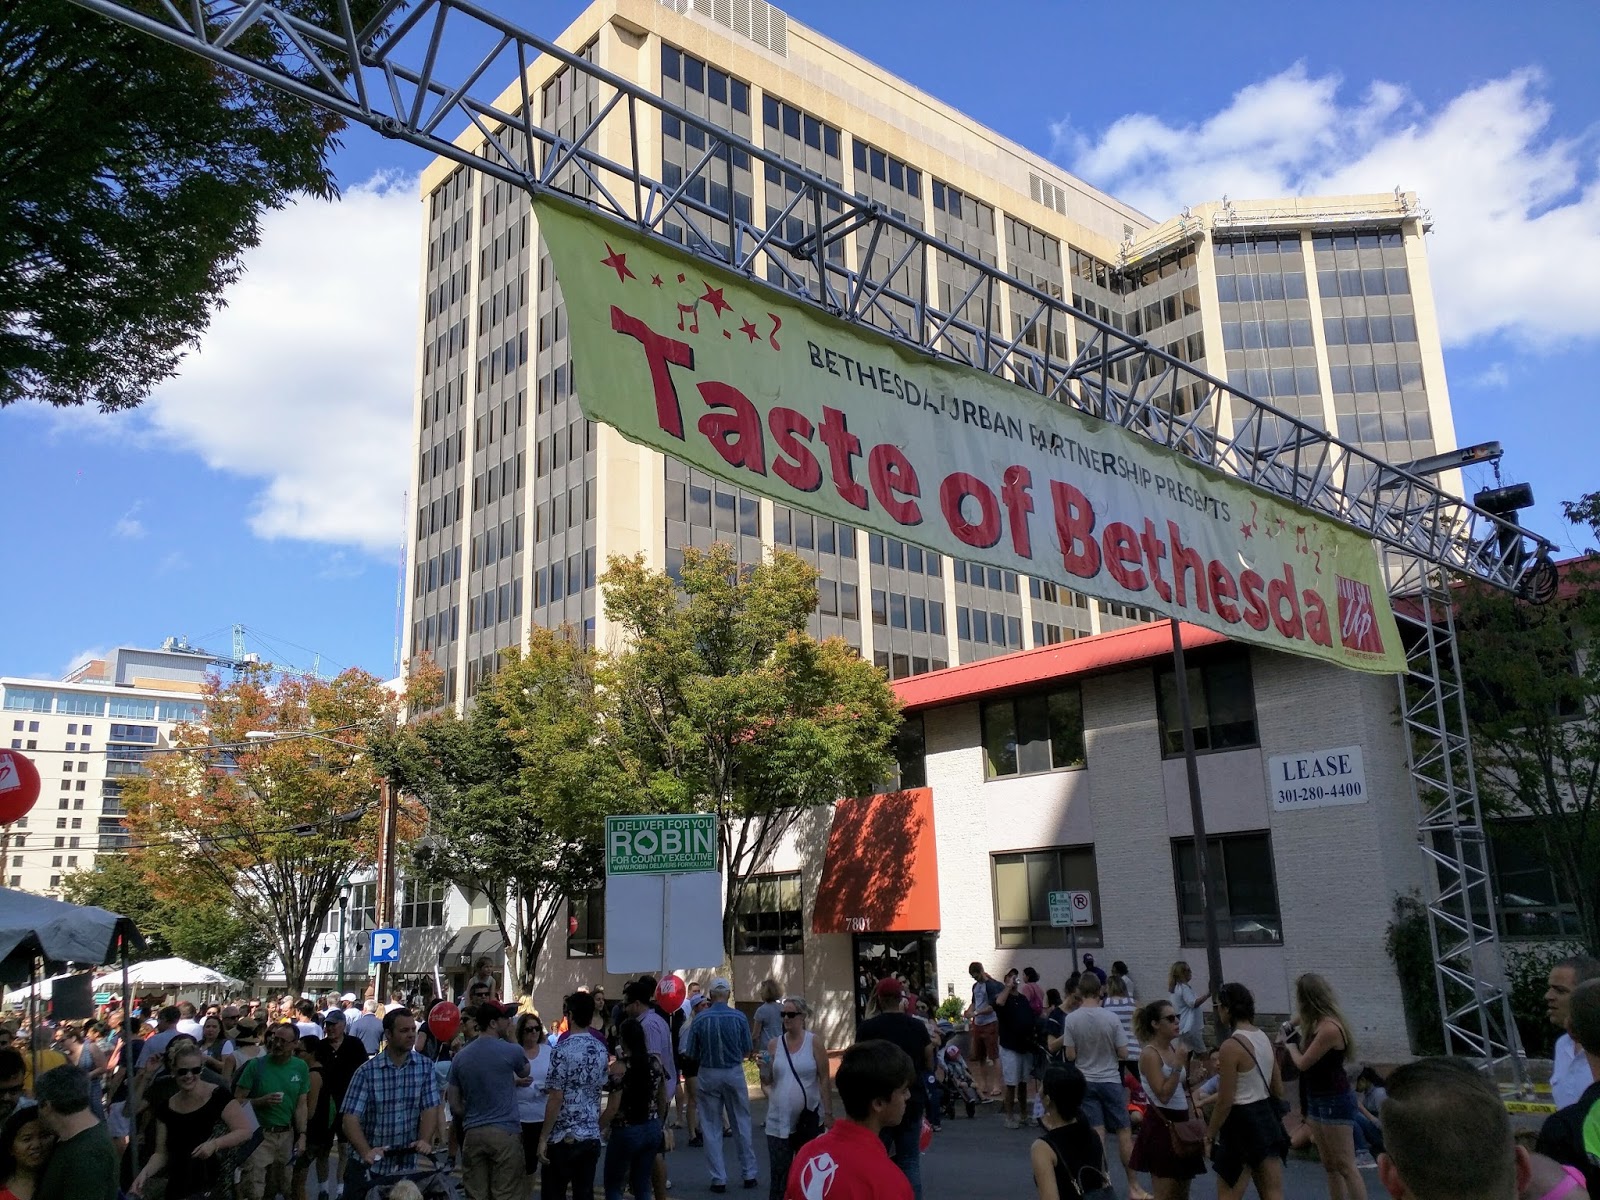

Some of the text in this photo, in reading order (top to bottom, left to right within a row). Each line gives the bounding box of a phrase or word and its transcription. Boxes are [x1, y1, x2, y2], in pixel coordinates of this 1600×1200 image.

[807, 340, 940, 415] BETHESDA
[941, 394, 1024, 443] URBAN
[1028, 423, 1152, 489] PARTNERSHIP
[610, 304, 1334, 648] Taste of Bethesda
[1282, 754, 1352, 781] LEASE
[1278, 781, 1362, 803] 301-280-4400
[617, 821, 664, 831] DELIVER
[668, 820, 690, 829] FOR
[692, 819, 712, 829] YOU
[611, 829, 712, 856] ROBIN
[611, 853, 712, 864] FOR COUNTY EXECUTIVE
[374, 933, 395, 956] P
